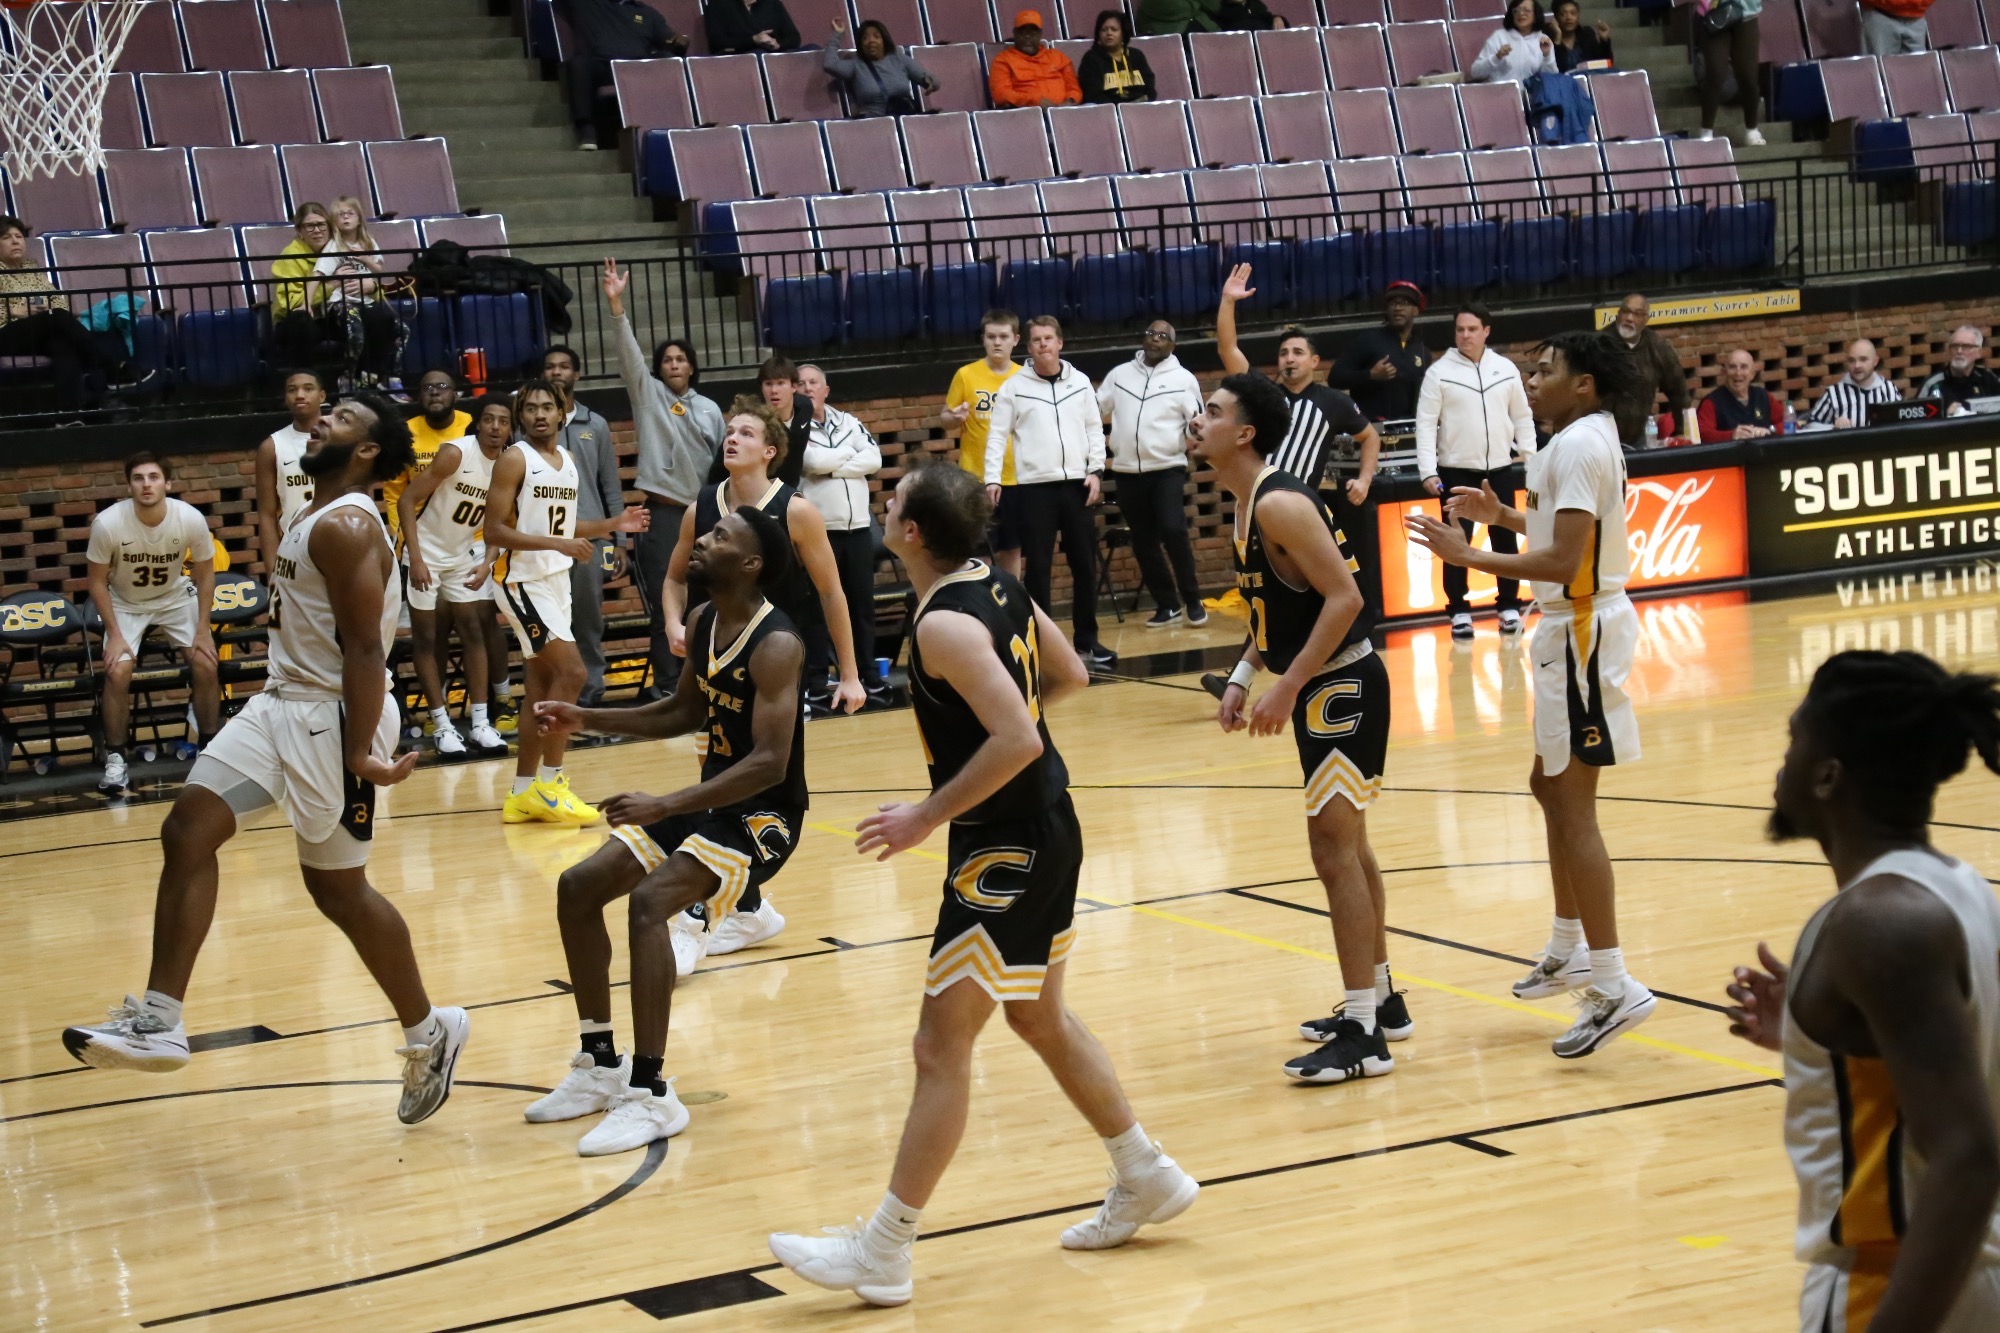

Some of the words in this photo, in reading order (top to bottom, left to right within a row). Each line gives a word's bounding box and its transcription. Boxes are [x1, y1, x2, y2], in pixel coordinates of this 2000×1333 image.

[1648, 304, 1709, 319] arramore
[1713, 297, 1760, 313] Scorer's
[1764, 293, 1798, 308] Table
[455, 482, 488, 500] SOUTH
[1780, 447, 2000, 515] 'SOUTHE
[548, 505, 567, 536] 12
[123, 551, 180, 563] SOUTHERN
[132, 566, 168, 587] 35
[211, 581, 258, 612] SC
[1306, 678, 1363, 739] C
[949, 846, 1036, 912] C
